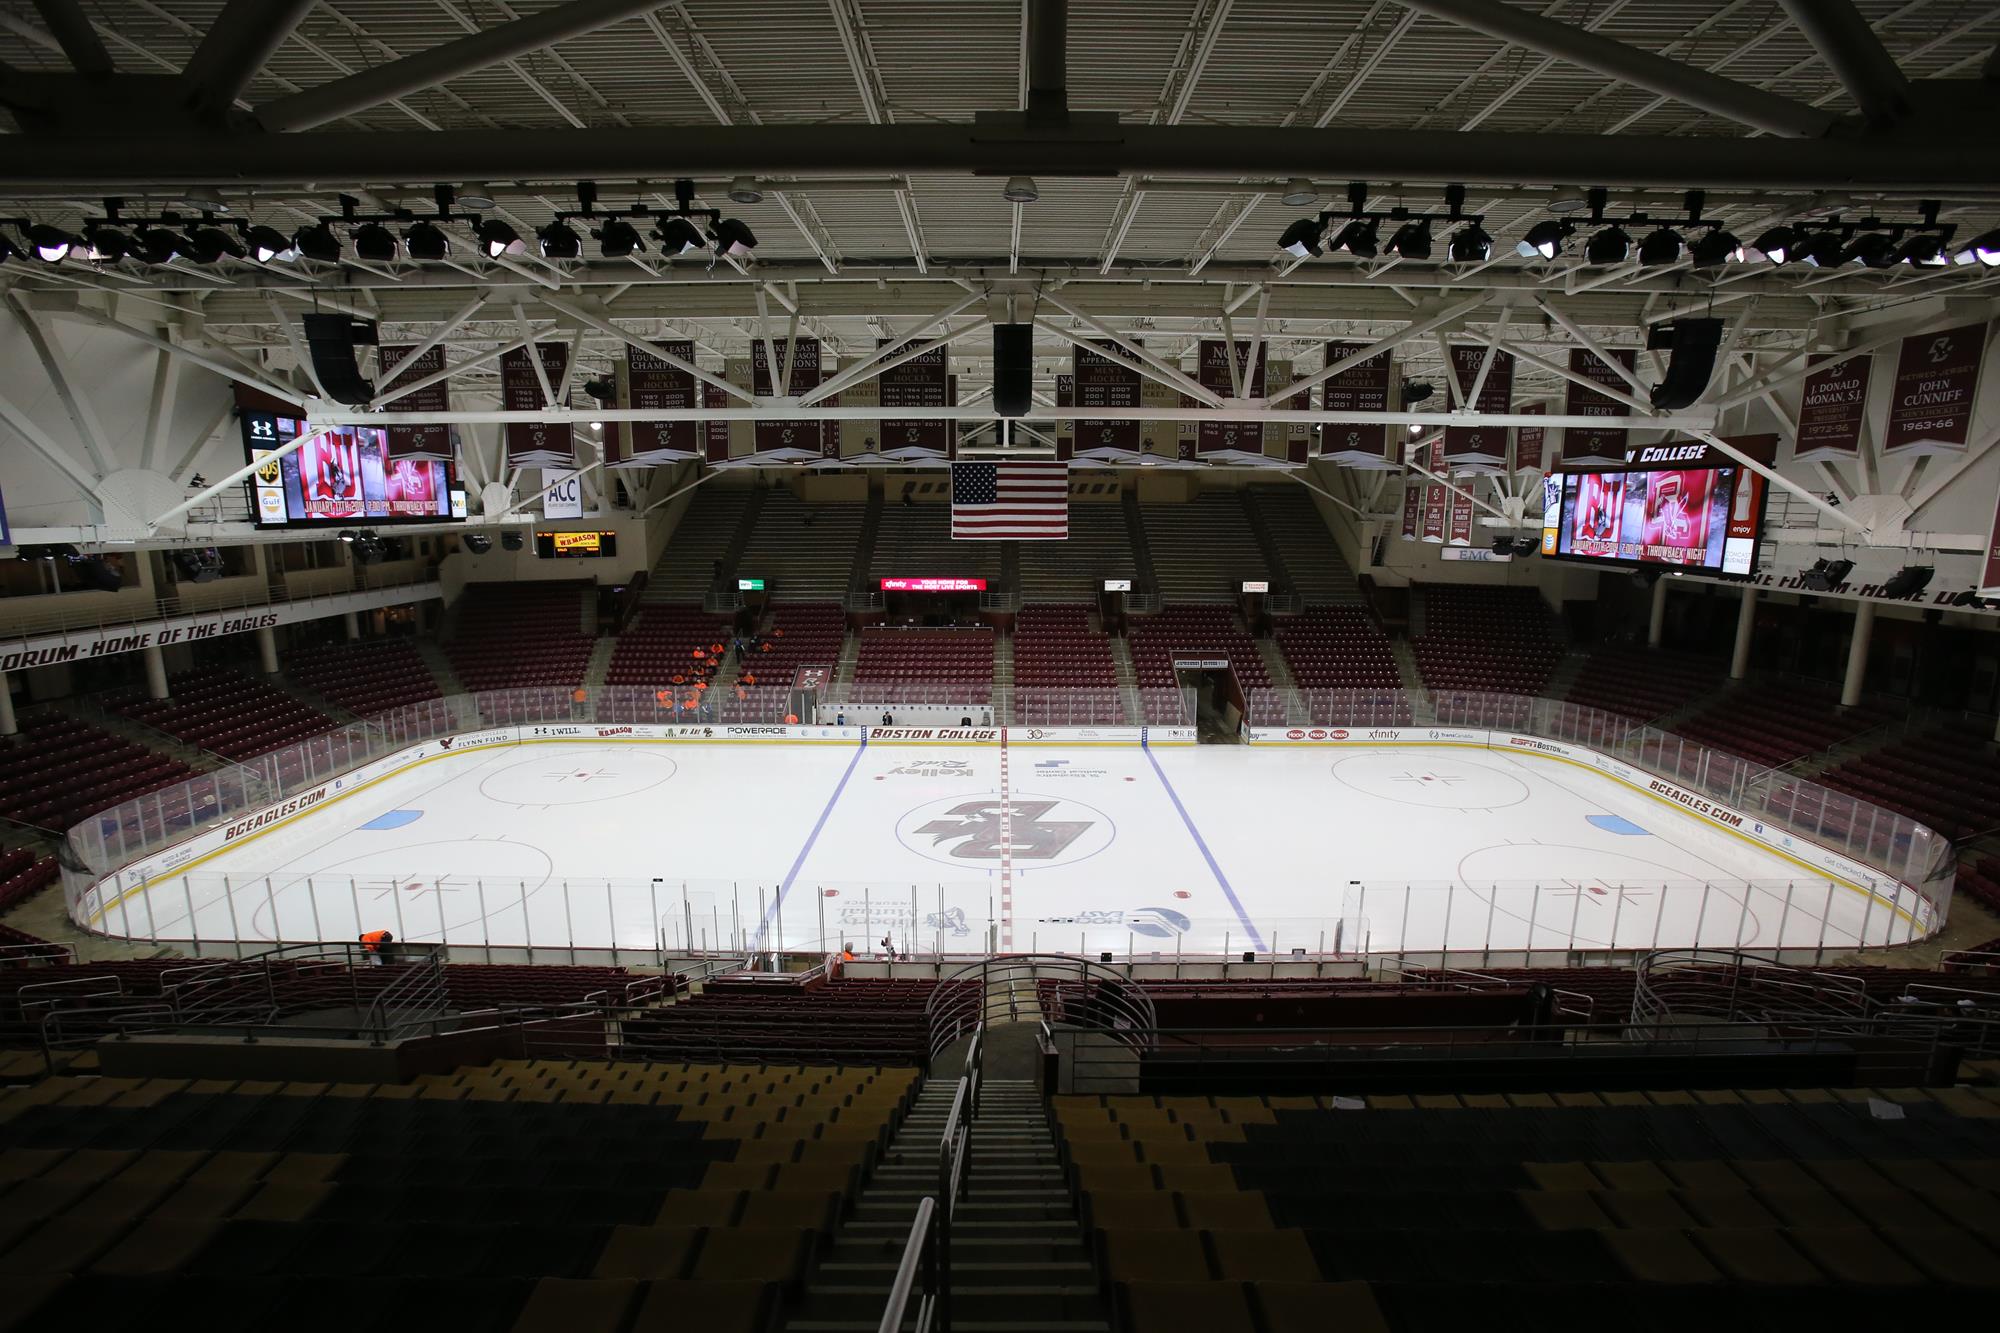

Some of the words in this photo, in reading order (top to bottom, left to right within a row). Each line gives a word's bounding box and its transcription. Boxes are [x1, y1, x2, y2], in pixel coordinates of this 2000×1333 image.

[669, 345, 691, 353] EAST
[795, 344, 816, 352] EAST
[521, 348, 547, 360] NT
[1089, 375, 1127, 383] HOCKEY
[1820, 379, 1860, 393] DONALD
[1917, 378, 1951, 395] JOHN
[1903, 388, 1963, 408] CUNNIFF
[1583, 406, 1615, 416] JERRY
[1901, 418, 1954, 432] 1963-66
[1640, 444, 1709, 463] COLLEGE
[548, 479, 576, 502] ACC
[262, 498, 280, 506] Gulf
[393, 501, 422, 512] THROWBACK
[1732, 526, 1751, 535] enjoy
[1647, 544, 1684, 559] THROWBACK
[1686, 547, 1707, 560] NIGHT
[885, 580, 906, 588] xfinity
[0, 645, 77, 671] ORUM
[90, 633, 151, 656] HOME
[157, 629, 182, 645] OF
[187, 623, 217, 639] THE
[222, 614, 278, 633] EAGLES
[727, 727, 788, 735] POWERADE
[870, 728, 932, 739] BOSTON
[937, 728, 997, 739] COLLEGE
[1368, 729, 1400, 740] xfinity
[458, 737, 483, 747] FLYNN
[485, 735, 508, 744] FUND
[911, 760, 970, 769] Rink
[888, 766, 974, 777] Kelley
[1649, 779, 1744, 828] BCEAGLES.COM
[224, 787, 327, 841] BCEAGLES.COM
[1823, 856, 1835, 867] Get
[1836, 861, 1862, 878] checked
